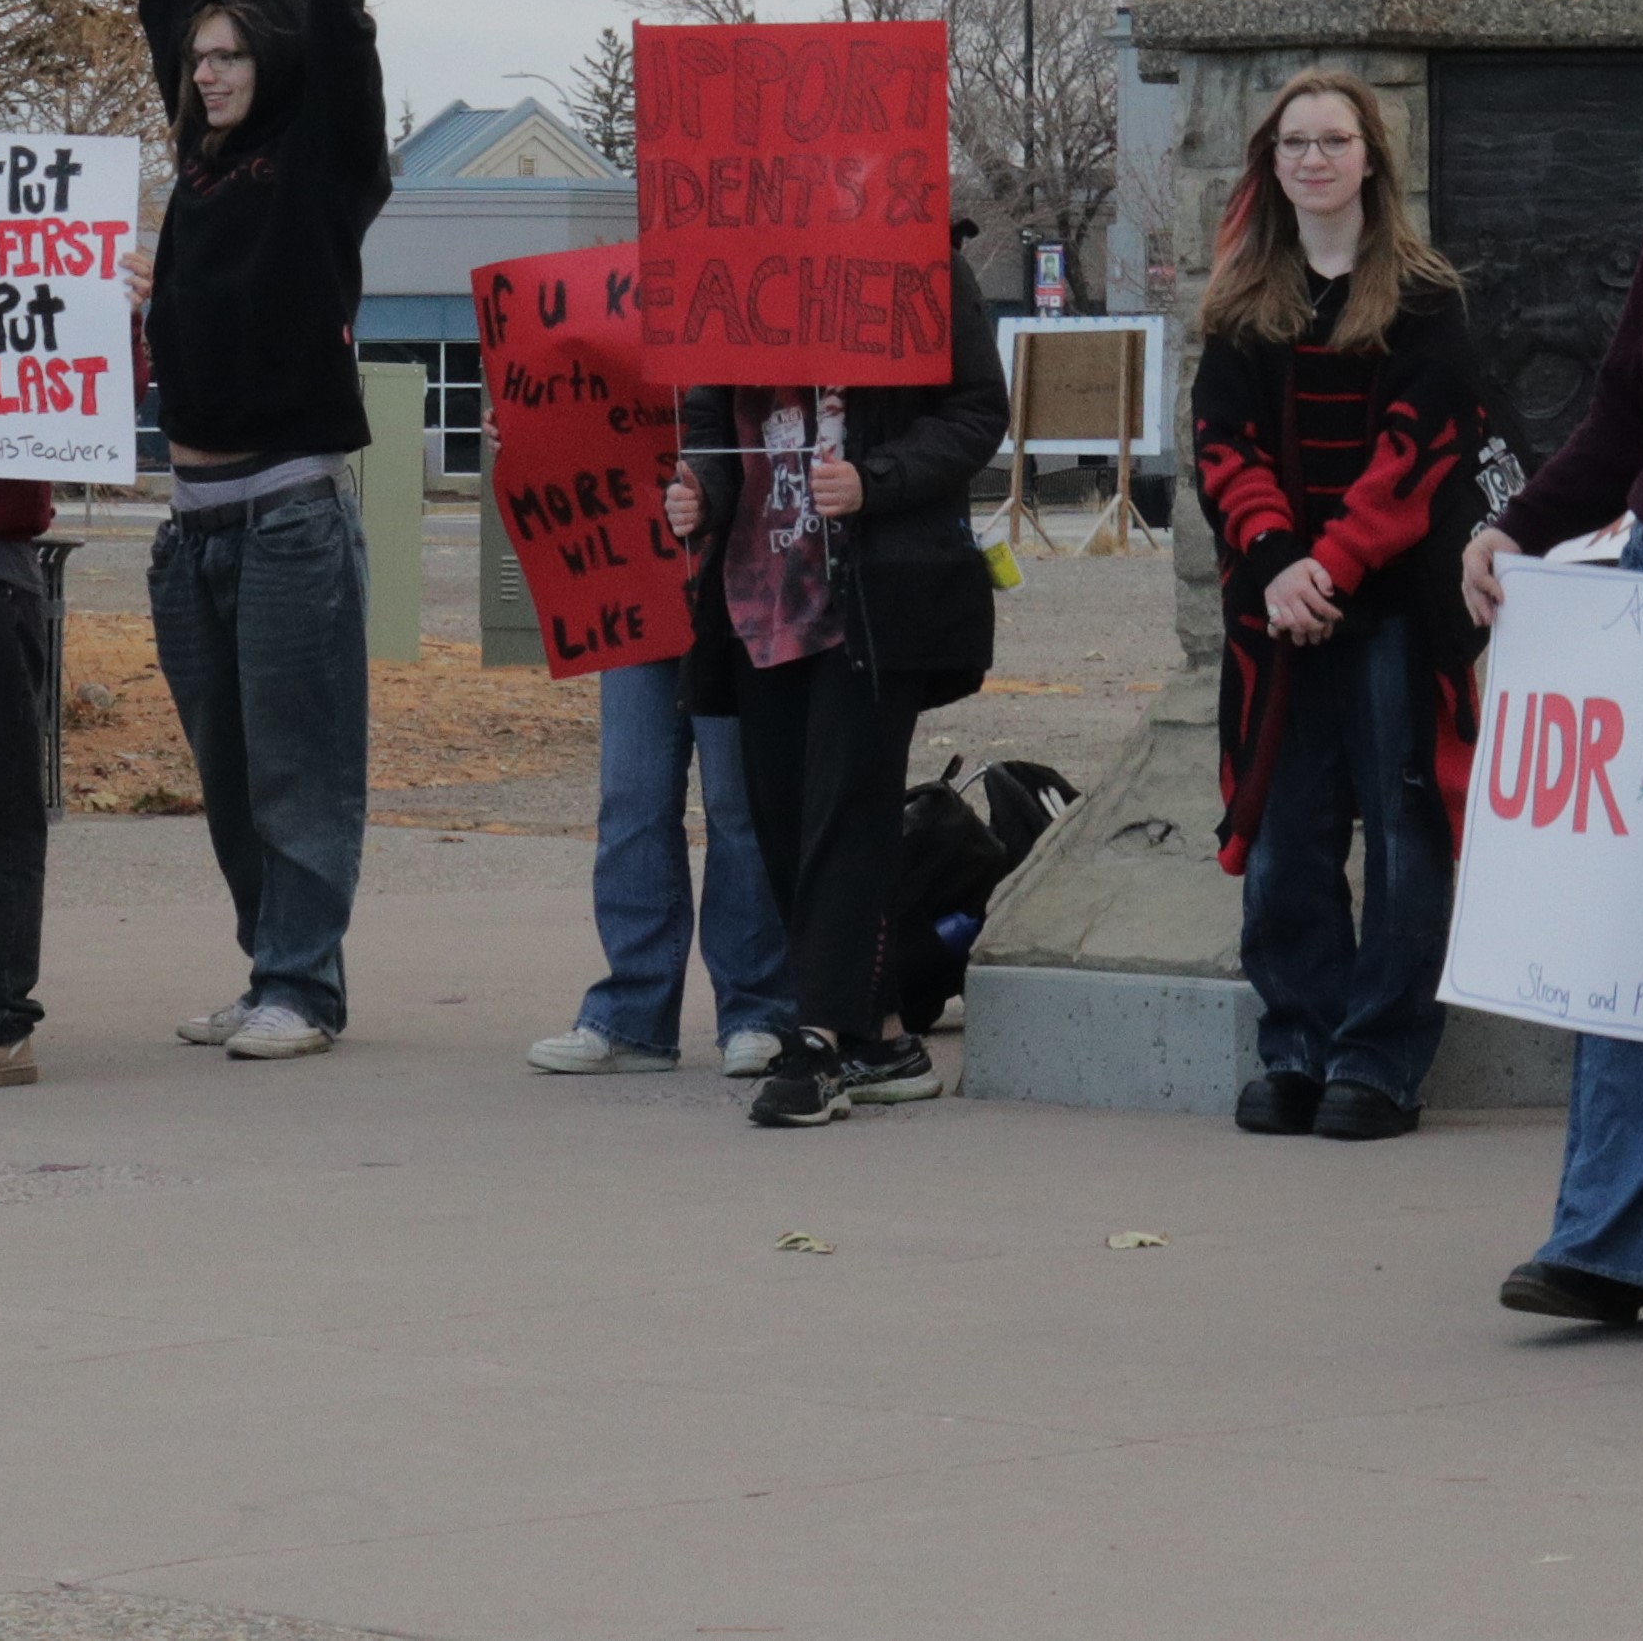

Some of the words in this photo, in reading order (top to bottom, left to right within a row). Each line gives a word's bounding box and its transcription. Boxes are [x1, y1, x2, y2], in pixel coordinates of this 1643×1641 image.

[8, 145, 83, 215] Put
[885, 148, 939, 227] &
[508, 468, 635, 541] MORE
[1489, 691, 1630, 836] UDR
[1517, 963, 1570, 1016] Strong
[1588, 983, 1619, 1015] and
